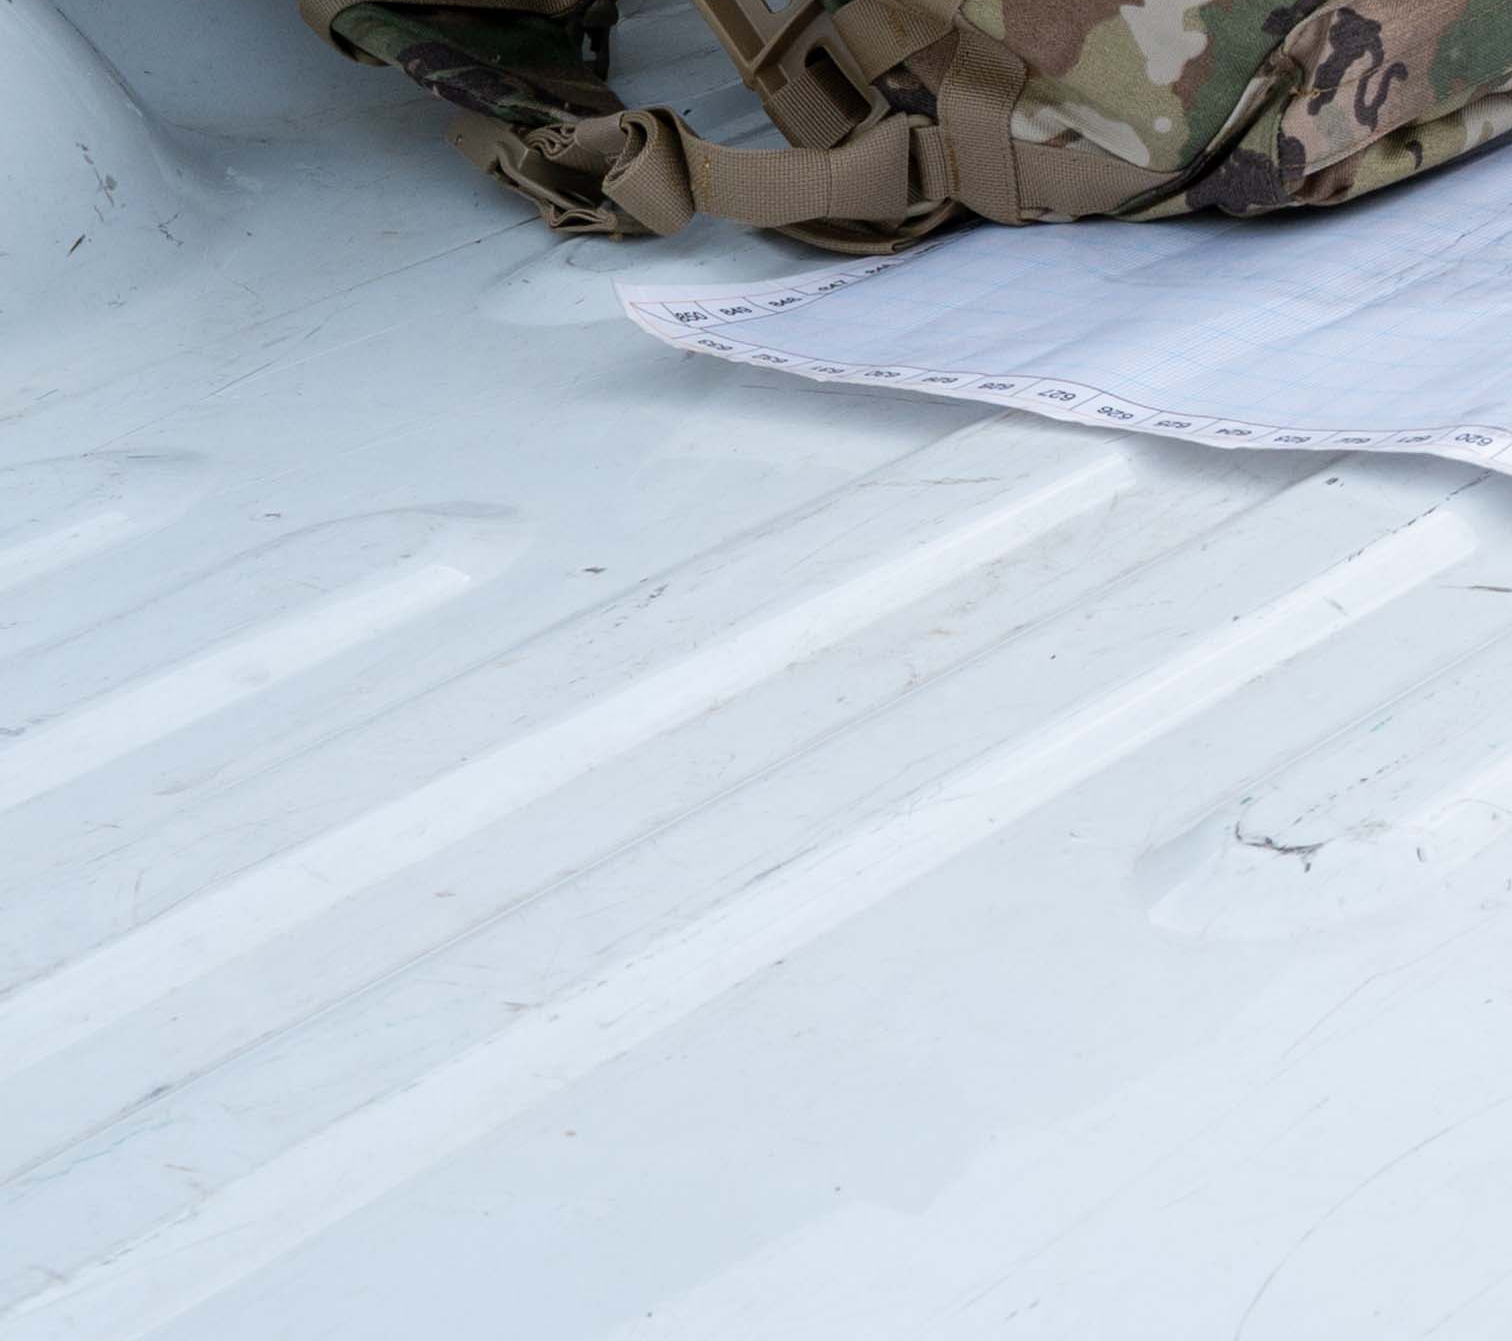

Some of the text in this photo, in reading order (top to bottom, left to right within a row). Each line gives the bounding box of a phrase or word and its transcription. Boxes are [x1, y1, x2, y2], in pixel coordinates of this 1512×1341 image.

[1038, 388, 1076, 403] 627
[1098, 405, 1134, 421] 626
[1454, 432, 1494, 448] 620
